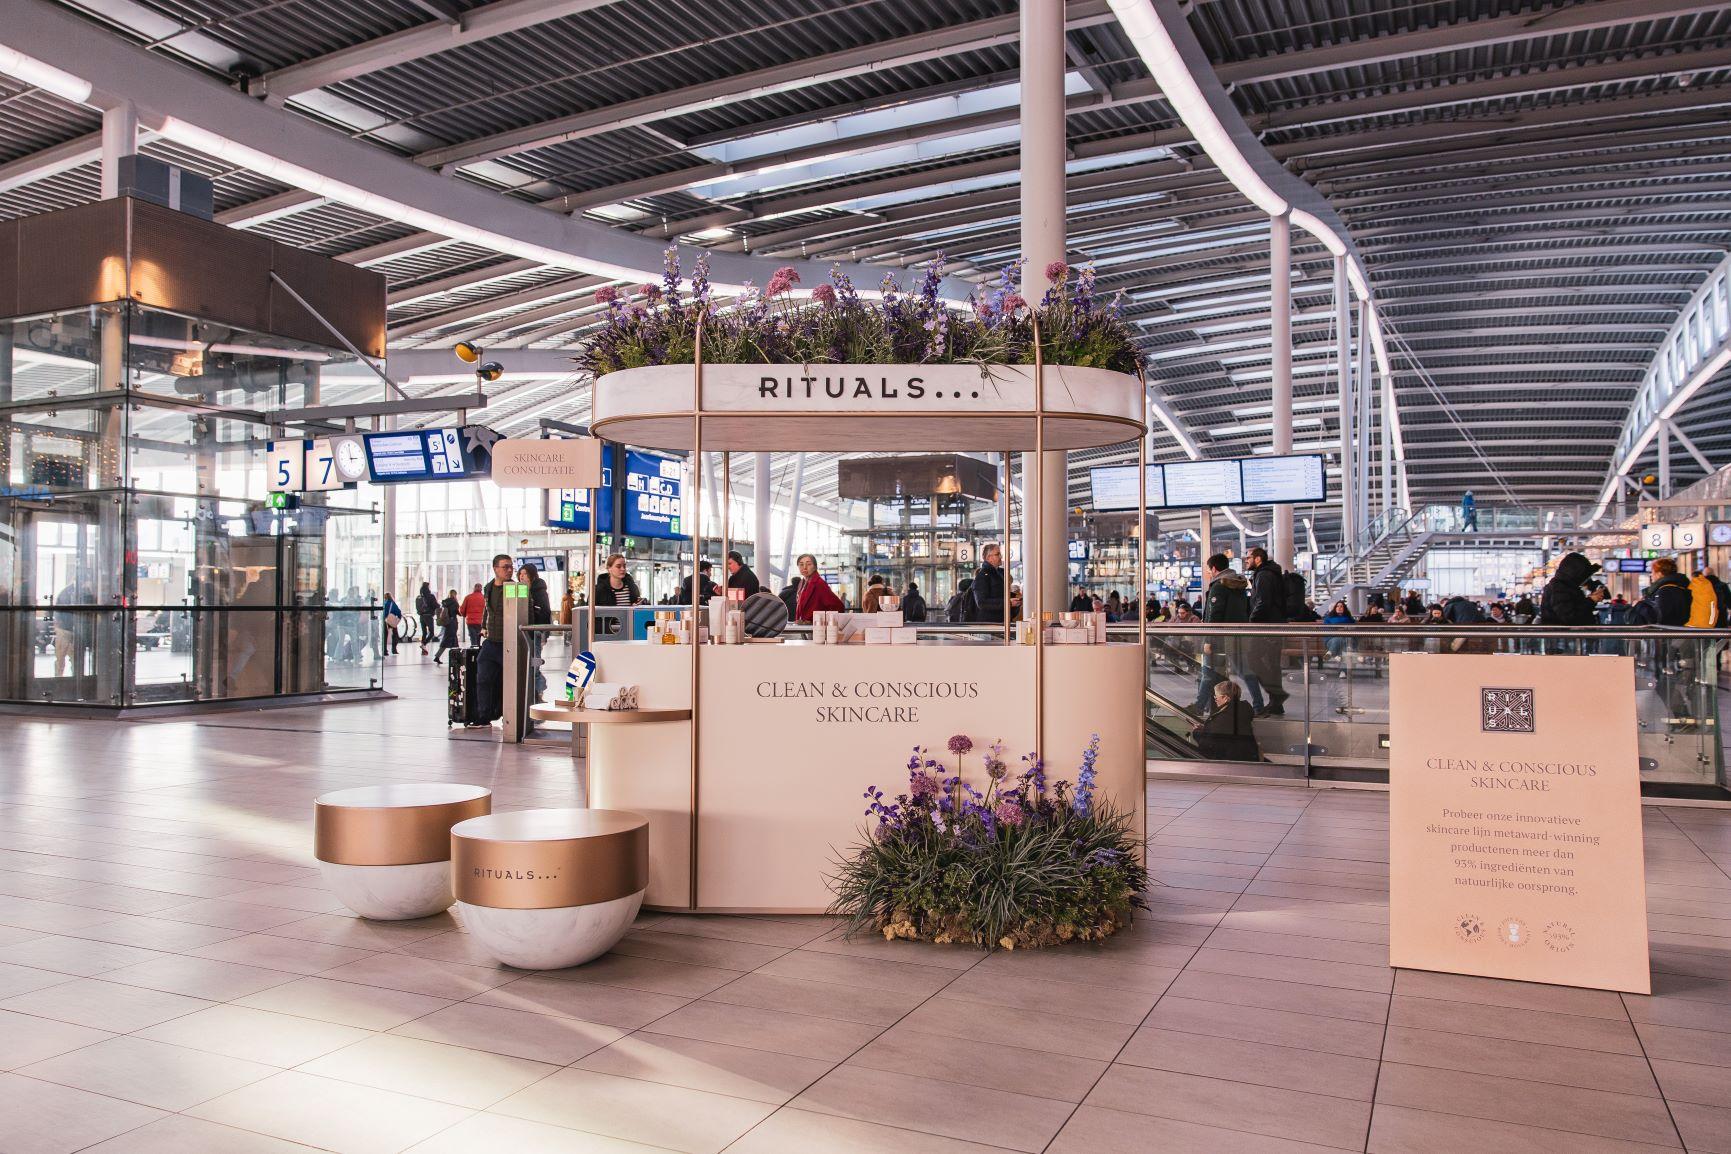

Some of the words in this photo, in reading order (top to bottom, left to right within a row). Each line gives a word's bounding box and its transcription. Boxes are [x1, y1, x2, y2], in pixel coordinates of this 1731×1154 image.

[758, 377, 979, 399] RITUALS...
[513, 453, 565, 463] SKINCARE
[278, 460, 290, 486] 5
[319, 457, 334, 485] 7
[503, 465, 575, 475] CONSULTATIE
[1652, 533, 1661, 547] 8
[1683, 533, 1693, 547] 9
[961, 549, 968, 560] 8
[756, 681, 824, 698] CLEAN
[831, 682, 848, 698] &
[854, 682, 978, 698] CONSCIOUS
[816, 706, 919, 723] SKINCARE
[1426, 758, 1477, 771] CLEAN
[1482, 761, 1495, 772] &
[1499, 762, 1597, 777] CONSCIOUS
[1471, 776, 1550, 792] SKINCARE
[1442, 808, 1483, 820] Probeer
[1486, 813, 1513, 822] onze
[1516, 812, 1581, 826] innovatieve
[1426, 824, 1470, 836] skincare
[1473, 827, 1491, 839] lijn
[1494, 830, 1600, 846] metaward-winning
[1451, 843, 1519, 856] productenen
[1522, 849, 1550, 858] meer
[1553, 849, 1574, 860] dan
[473, 867, 557, 880] RITUALS...
[1480, 860, 1550, 875] ingrediënten
[1553, 868, 1574, 877] van
[1455, 876, 1514, 890] natuurlijke
[1517, 883, 1578, 896] oorsprong.
